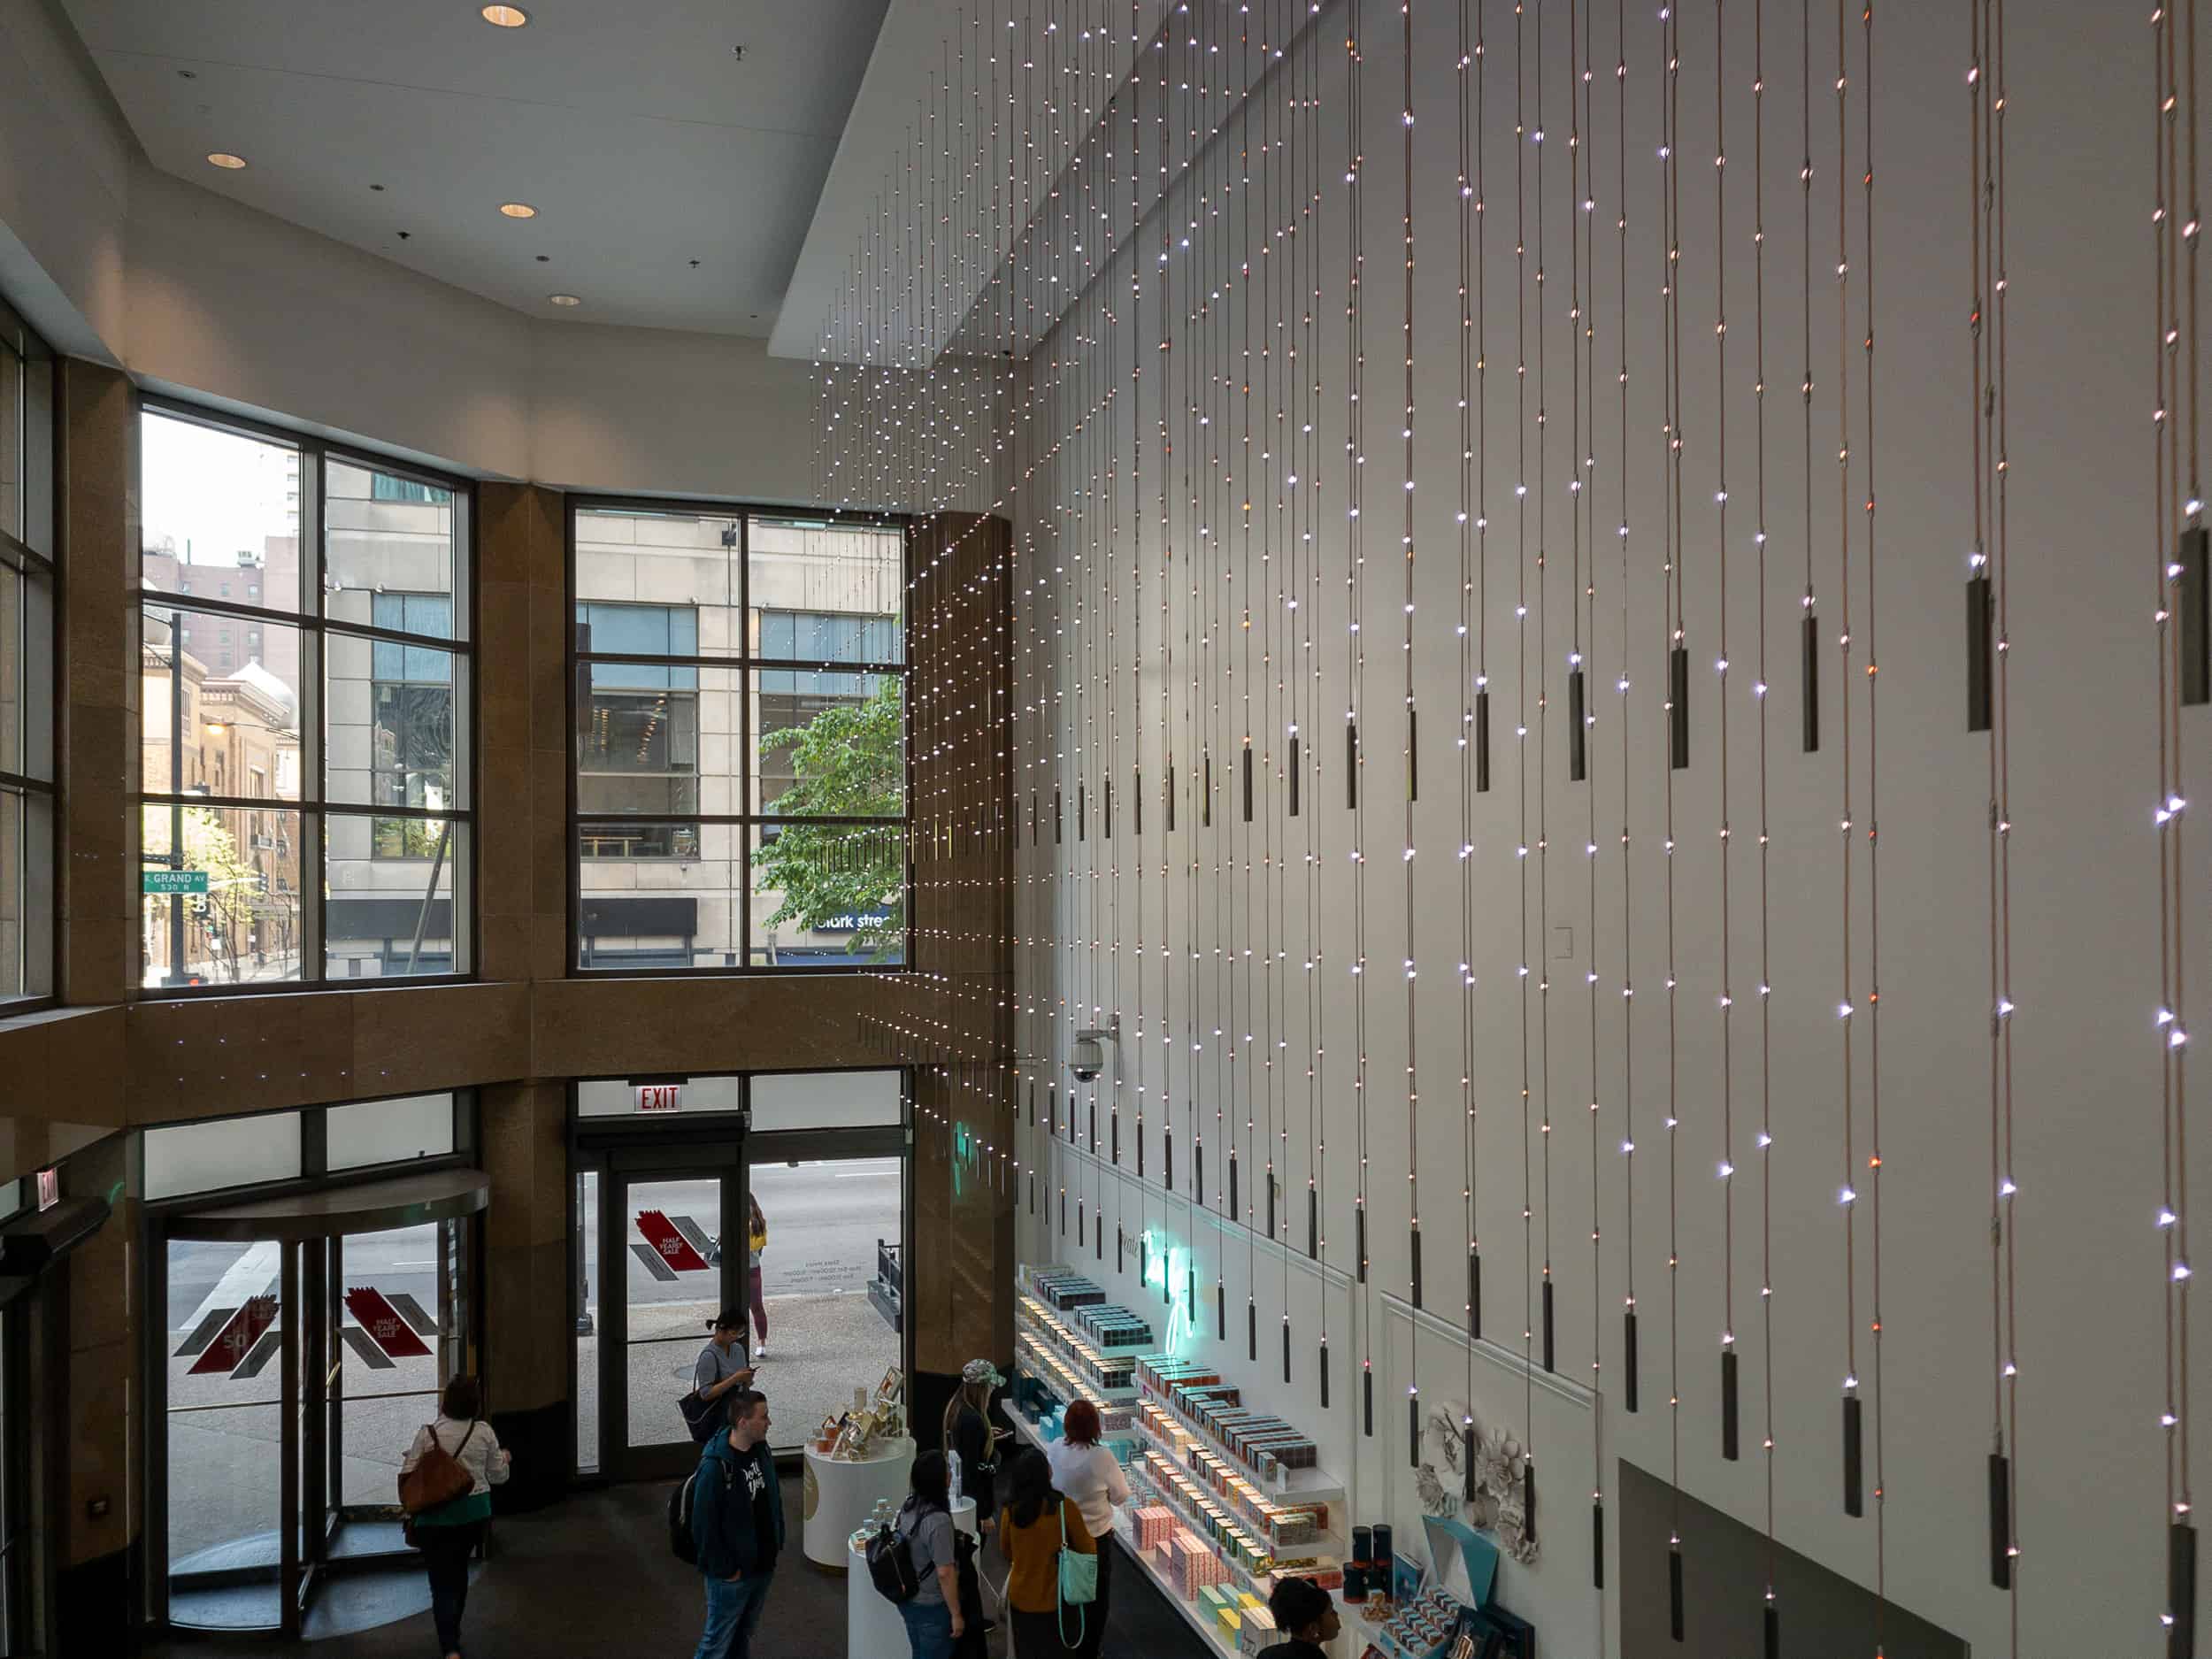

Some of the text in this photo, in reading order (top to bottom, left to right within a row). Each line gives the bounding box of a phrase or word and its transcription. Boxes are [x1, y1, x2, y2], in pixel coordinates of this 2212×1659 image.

[154, 873, 192, 883] GRAND
[856, 914, 895, 928] stre
[642, 1087, 678, 1109] EXIT
